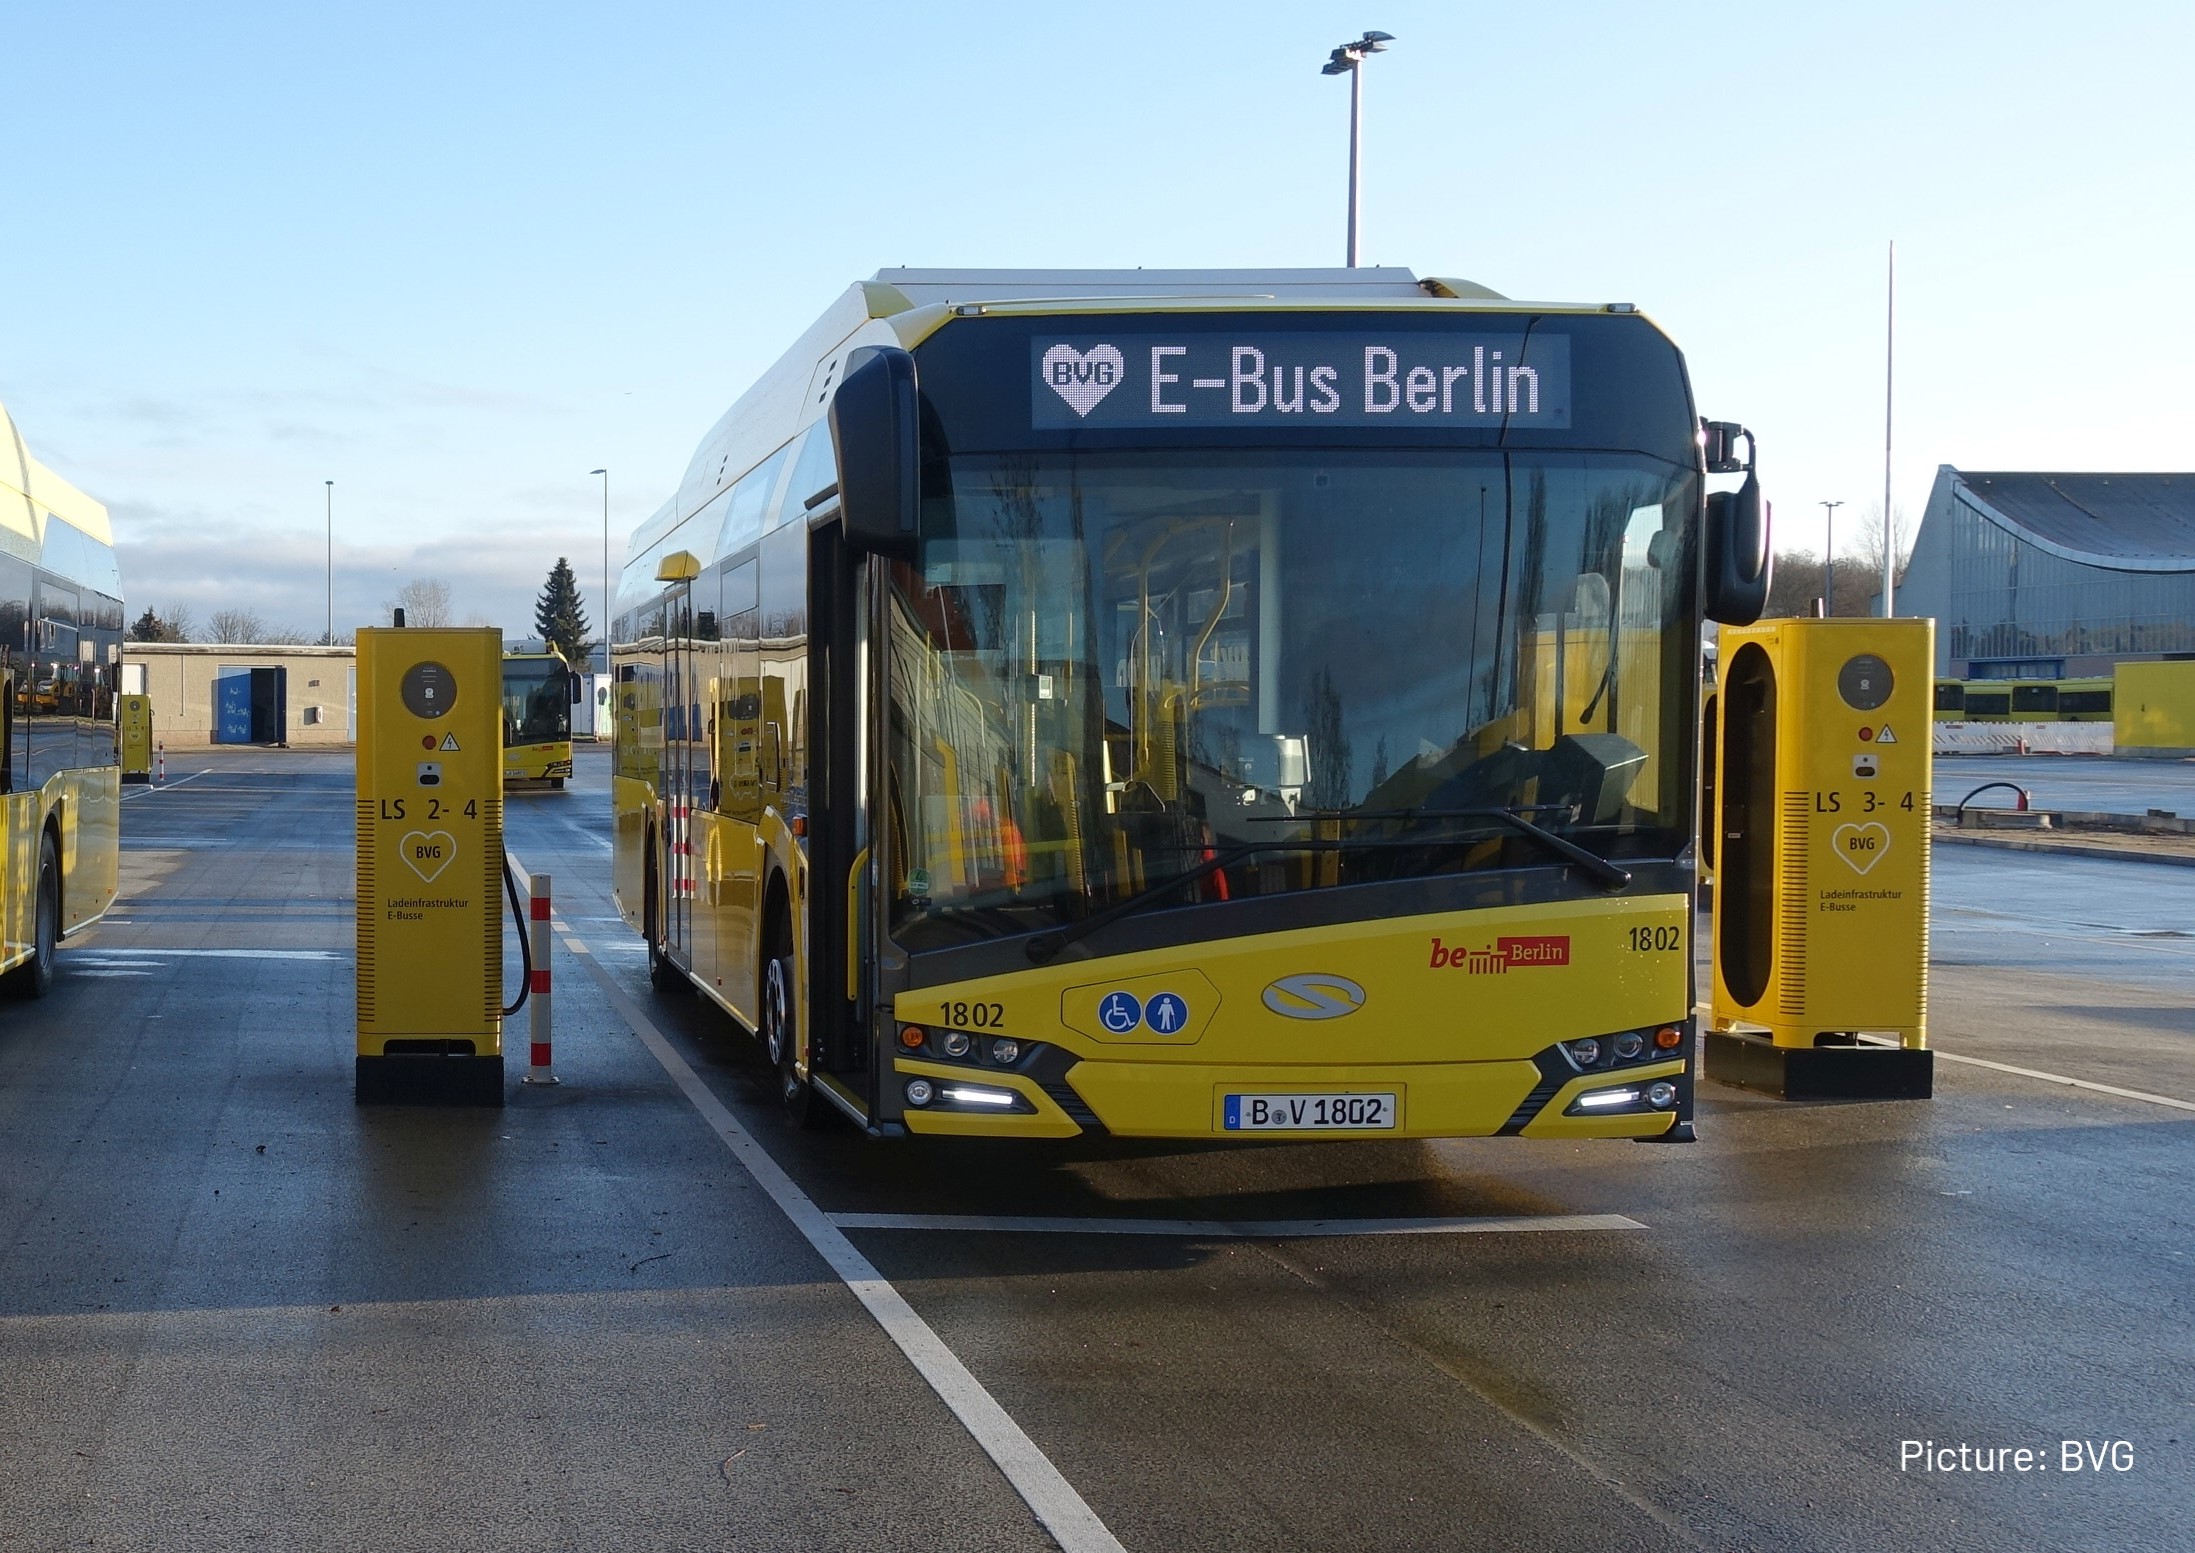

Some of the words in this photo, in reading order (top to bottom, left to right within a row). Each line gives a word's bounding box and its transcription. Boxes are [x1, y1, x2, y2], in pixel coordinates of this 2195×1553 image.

[1053, 361, 1114, 385] BVG
[1151, 346, 1340, 413] E-Bus
[1364, 346, 1538, 413] Berlin
[381, 799, 406, 819] LS
[463, 799, 477, 819] 4
[1816, 791, 1841, 812] LS
[1900, 791, 1914, 812] 4
[1849, 837, 1875, 850] BVG
[416, 846, 441, 858] BVG
[1820, 889, 1902, 899] Ladeinfrastruktur
[387, 898, 469, 908] Ladeinfrastruktur
[1820, 902, 1857, 911] E-Busse
[387, 911, 424, 920] E-Busse
[1628, 926, 1680, 951] 1802
[1429, 938, 1467, 968] be
[1510, 943, 1563, 961] Berlin
[940, 1002, 1004, 1028] 1802
[1229, 1115, 1236, 1124] D
[1252, 1099, 1269, 1125] B
[1289, 1099, 1306, 1125] V
[1313, 1098, 1383, 1125] 1802
